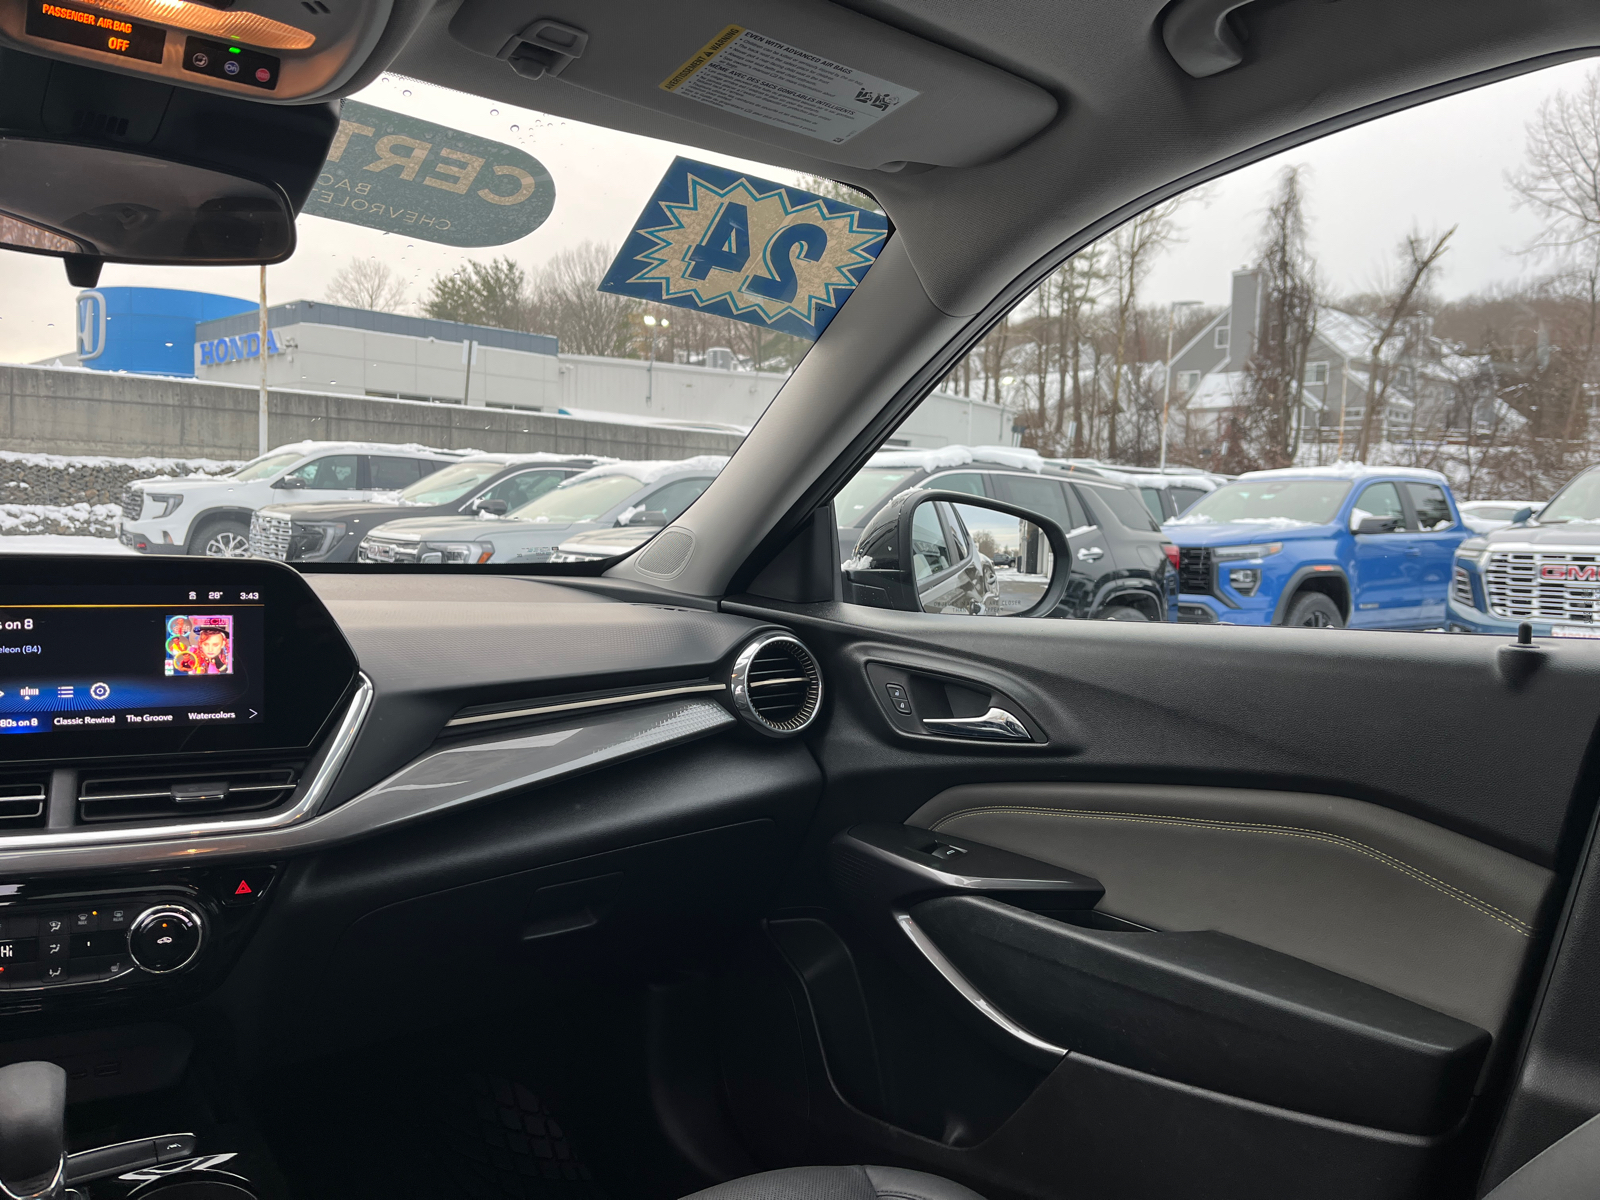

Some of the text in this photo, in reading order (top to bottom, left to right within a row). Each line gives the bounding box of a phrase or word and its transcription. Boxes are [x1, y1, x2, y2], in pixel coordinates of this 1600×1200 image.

[42, 3, 95, 25] PASSENGER
[108, 36, 130, 52] OFF
[709, 28, 739, 51] WARNING
[744, 32, 853, 75] EVEN WITH ADVANCED AIR BAGS
[665, 56, 706, 90] AVERTISSEMENT
[728, 70, 749, 79] AVEC
[759, 80, 780, 90] SACS
[776, 86, 818, 103] GONFLABLES
[814, 100, 856, 116] INTELLIGENTS
[200, 329, 280, 366] HONDA
[1541, 564, 1600, 581] GM
[240, 591, 259, 600] 3:43
[5, 620, 21, 630] on
[24, 618, 34, 630] 8
[22, 644, 42, 655] (84)
[0, 718, 38, 727] 80s on 8
[53, 715, 116, 725] Classic Rewind
[126, 713, 173, 723] The Groove
[188, 711, 236, 720] Watercolors
[0, 945, 13, 958] Hi
